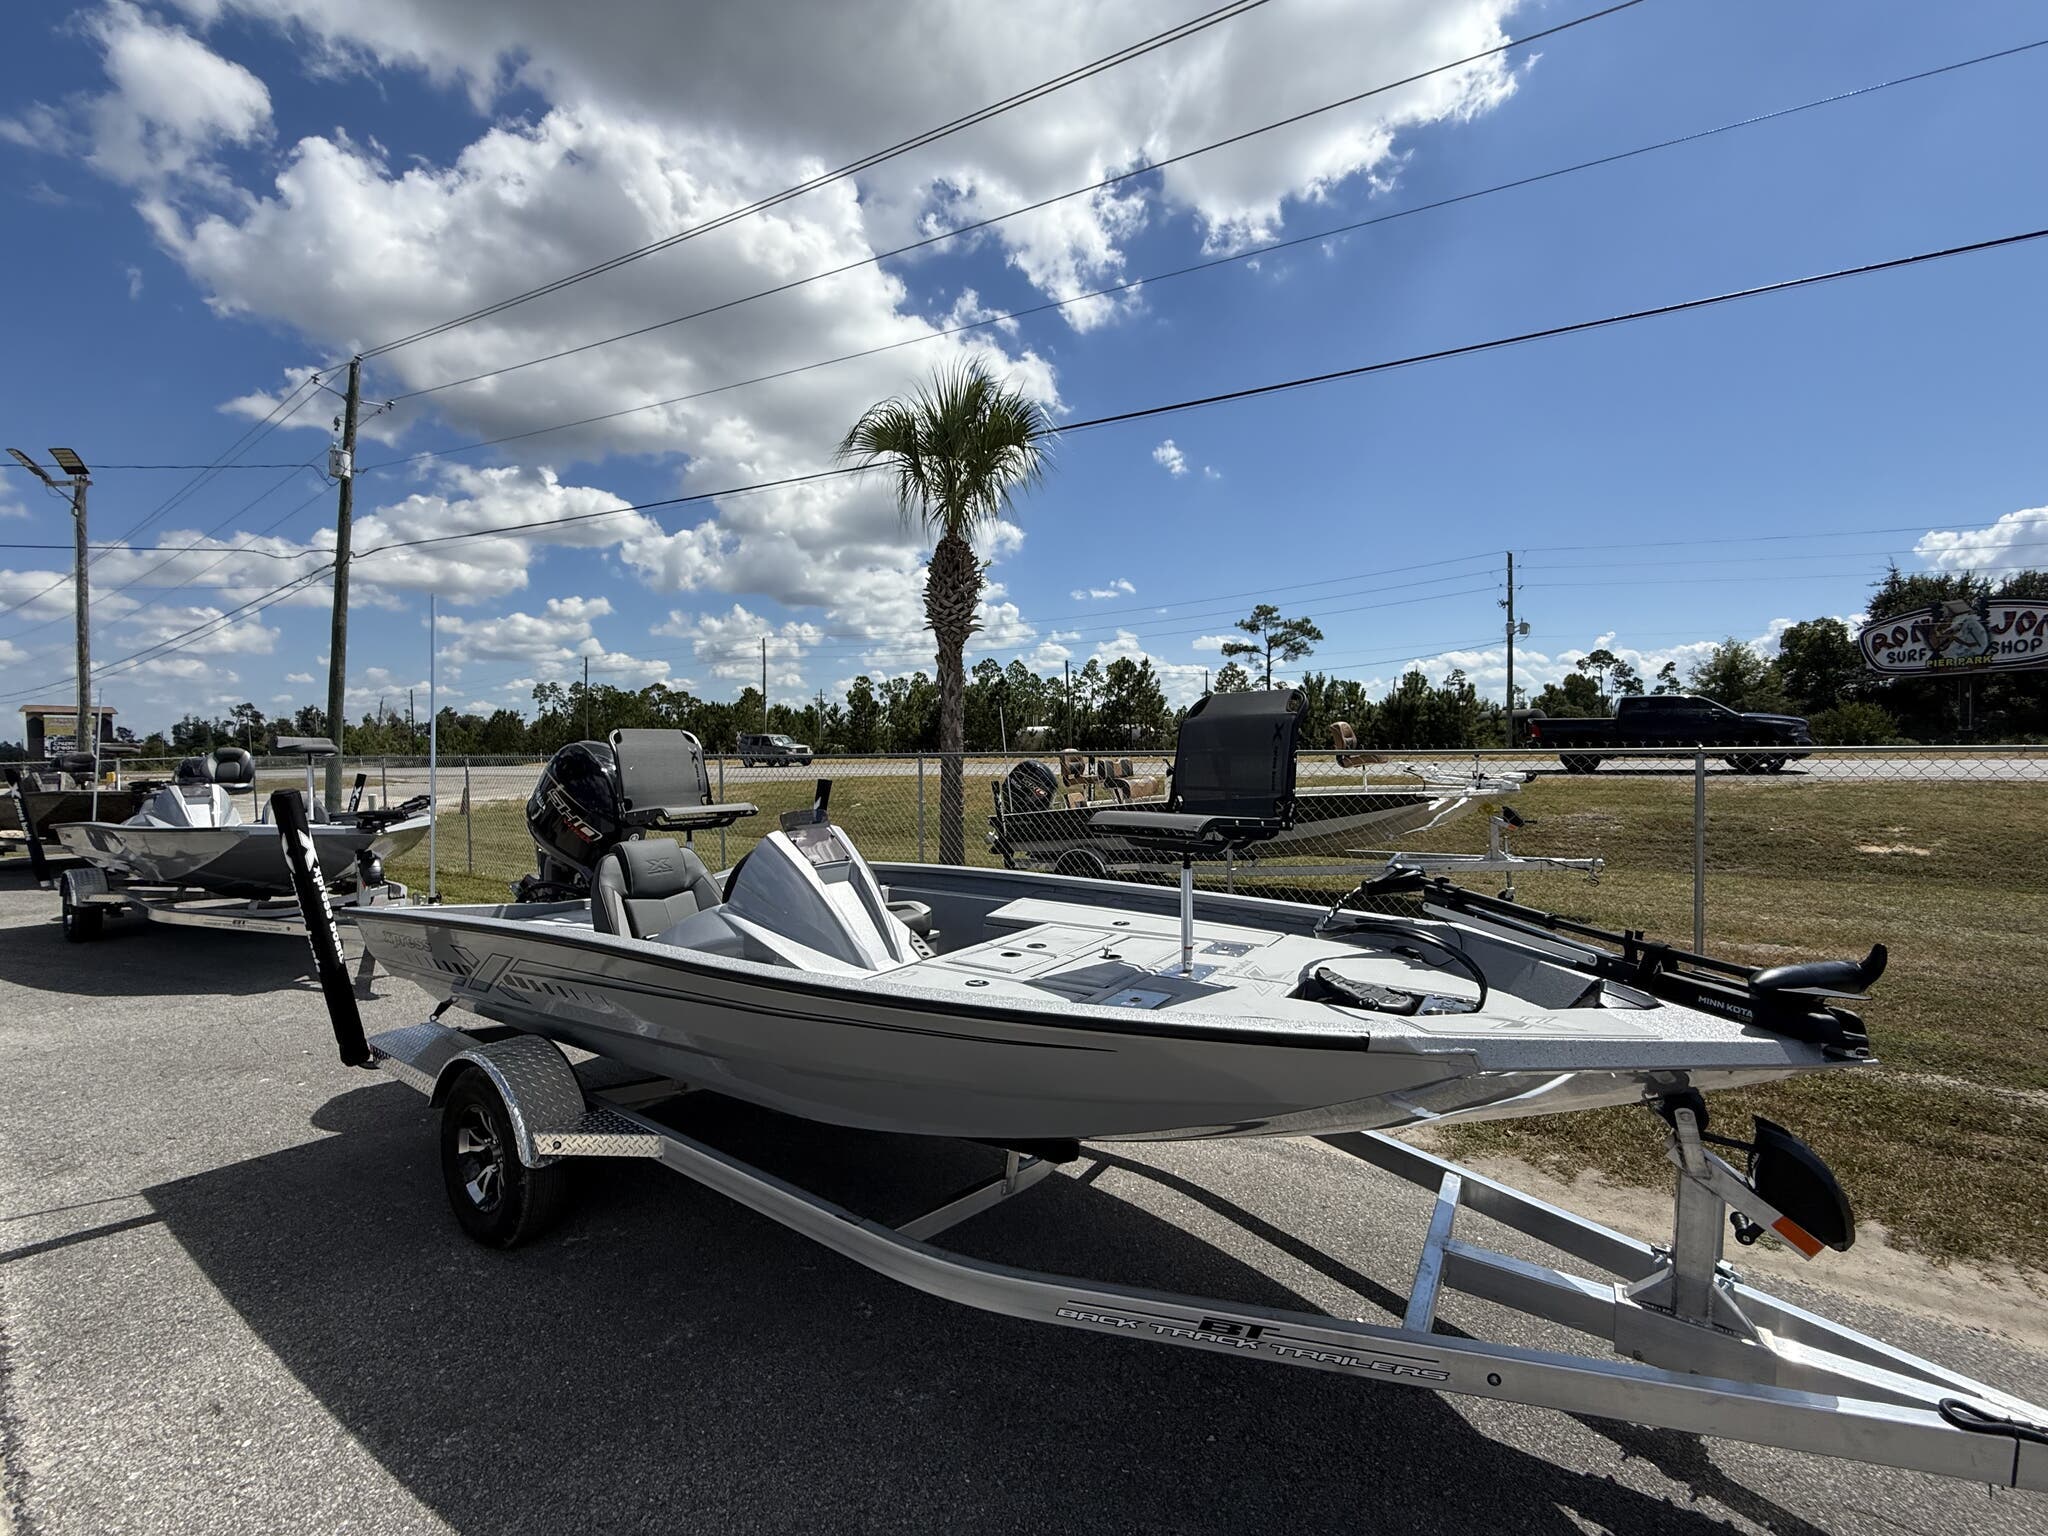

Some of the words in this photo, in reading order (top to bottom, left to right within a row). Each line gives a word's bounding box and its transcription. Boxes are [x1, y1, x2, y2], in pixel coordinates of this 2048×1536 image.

[1886, 647, 1927, 664] SURF
[1990, 637, 2043, 655] SHOP
[1926, 656, 1957, 668] PIER
[1957, 654, 1993, 666] PARK
[312, 865, 333, 919] xpress
[1698, 995, 1725, 1009] MINN
[1726, 1003, 1753, 1018] KOTA
[1056, 1308, 1142, 1330] BACK
[1148, 1321, 1265, 1351] TRACK
[1269, 1342, 1450, 1382] TRAILERS
